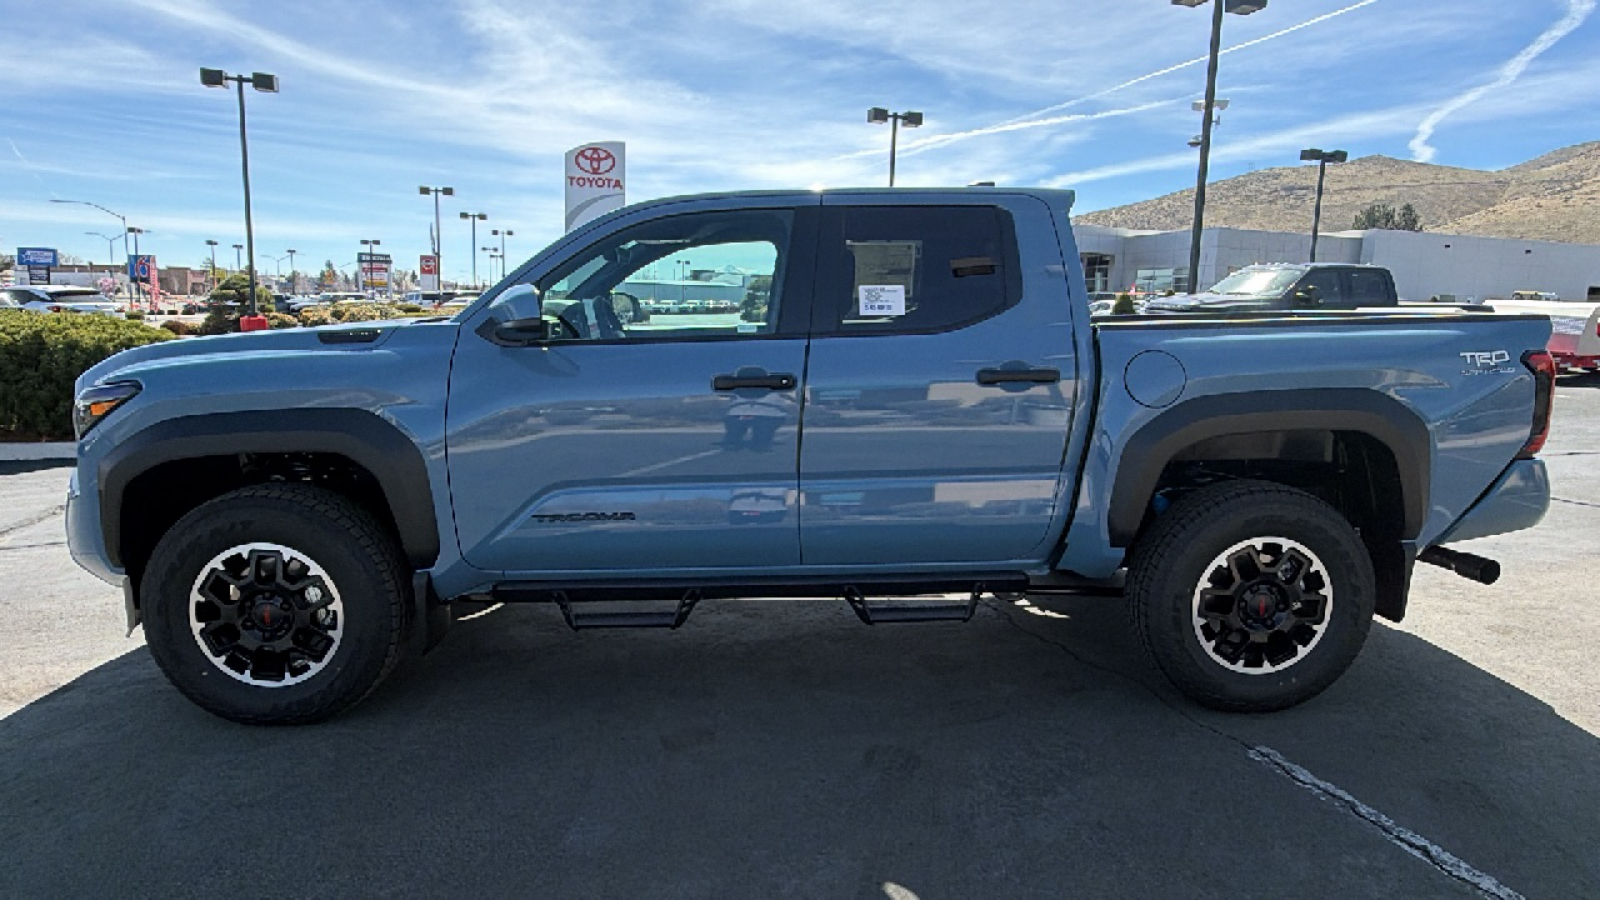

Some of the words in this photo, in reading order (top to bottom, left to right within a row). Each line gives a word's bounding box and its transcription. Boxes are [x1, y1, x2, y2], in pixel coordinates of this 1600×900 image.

[567, 176, 623, 190] TOYOTA
[1459, 349, 1511, 367] TRD
[530, 511, 636, 522] TACOMA
